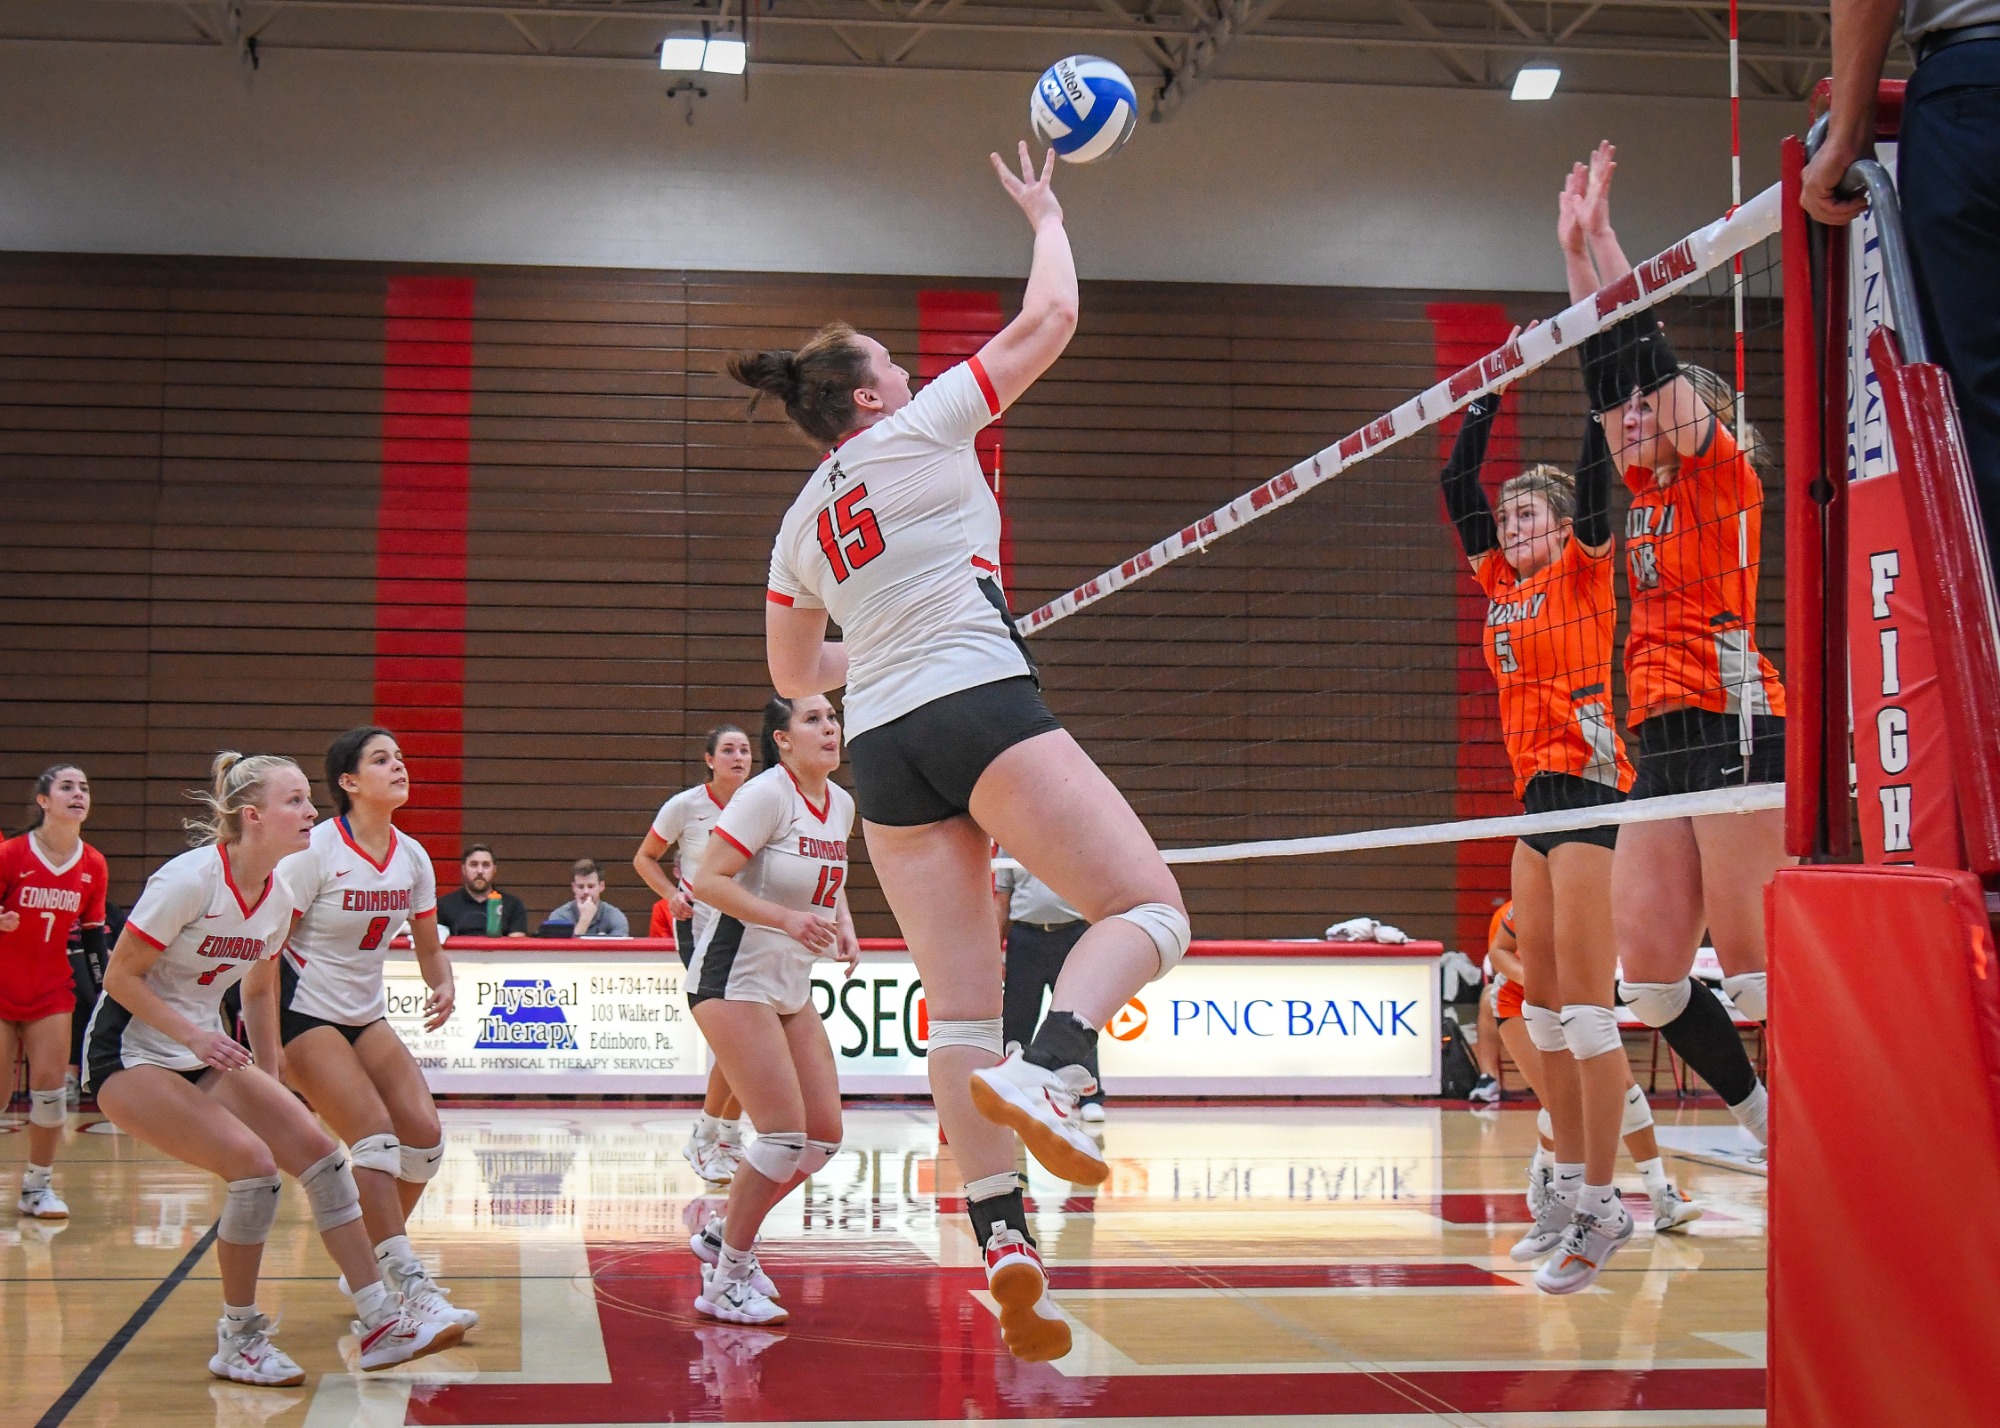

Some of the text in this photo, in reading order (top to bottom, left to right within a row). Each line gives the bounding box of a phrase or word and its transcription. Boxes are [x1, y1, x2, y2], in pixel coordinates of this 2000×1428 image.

[817, 482, 886, 585] 15
[1494, 630, 1519, 674] 5
[1869, 549, 1915, 868] FIGH
[799, 836, 848, 861] EDINBO
[811, 865, 844, 909] 12
[40, 911, 56, 943] 7
[359, 916, 391, 950] 8
[196, 935, 265, 961] EDINBOR
[477, 981, 578, 1013] Physical
[590, 977, 678, 995] 814-734-7444
[592, 1004, 682, 1022] 103 Walker Dr.
[1169, 999, 1419, 1037] PNC BANK
[478, 1017, 578, 1049] Therapy
[590, 1032, 674, 1051] Edinboro, Pa.
[452, 1057, 477, 1069] ALL
[481, 1057, 545, 1069] PHYSICAL
[548, 1057, 609, 1069] THERAPY
